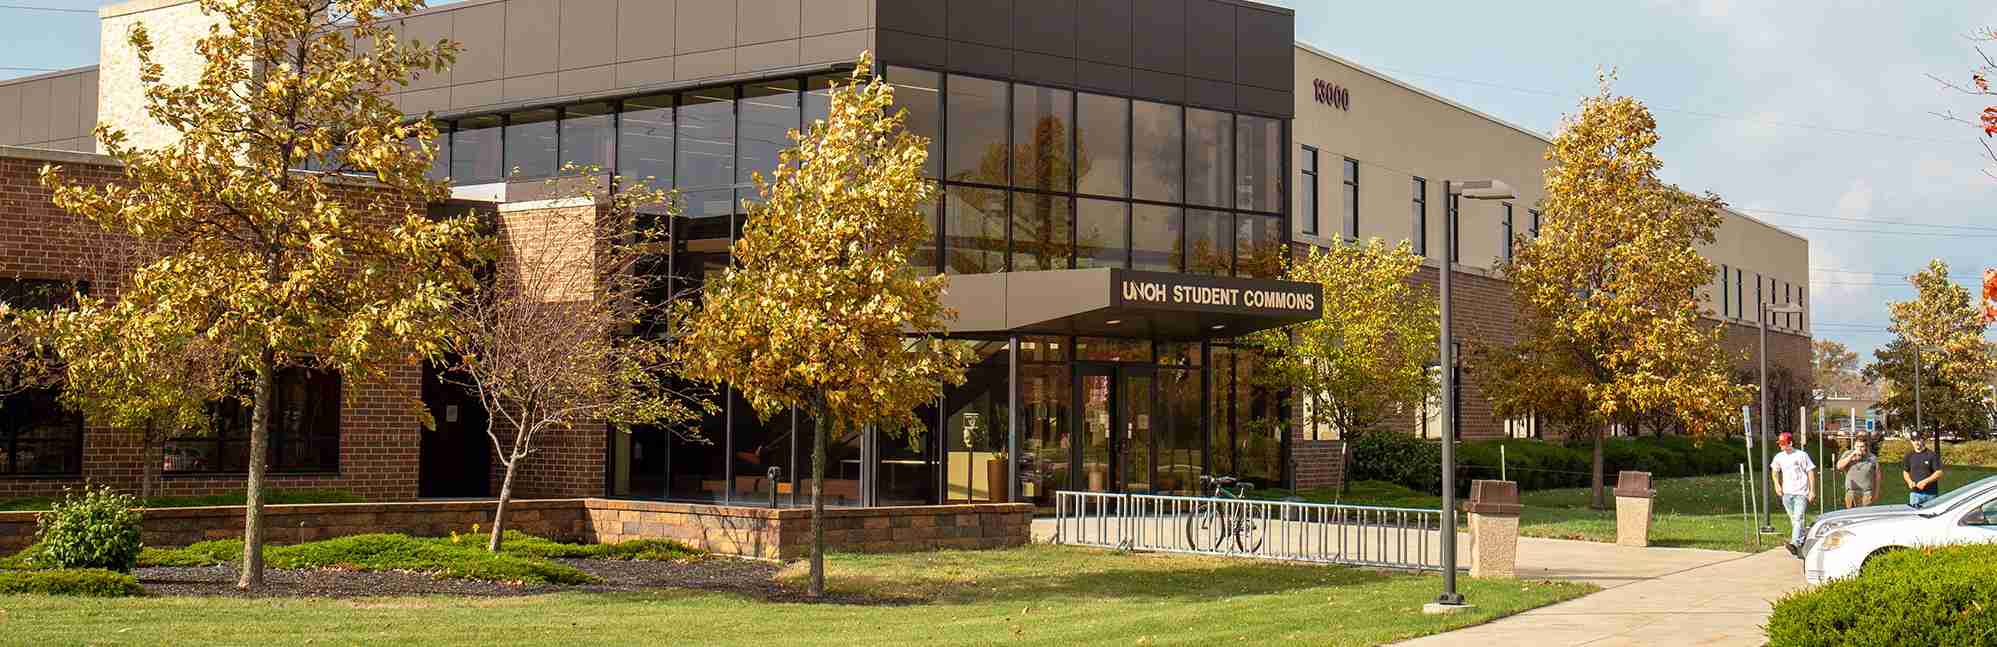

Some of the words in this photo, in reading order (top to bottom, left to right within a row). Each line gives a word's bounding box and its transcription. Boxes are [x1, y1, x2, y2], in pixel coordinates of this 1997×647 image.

[1312, 78, 1350, 112] 13000
[1122, 280, 1166, 302] UNOH
[1173, 284, 1239, 306] STUDENT
[1243, 289, 1315, 311] COMMONS
